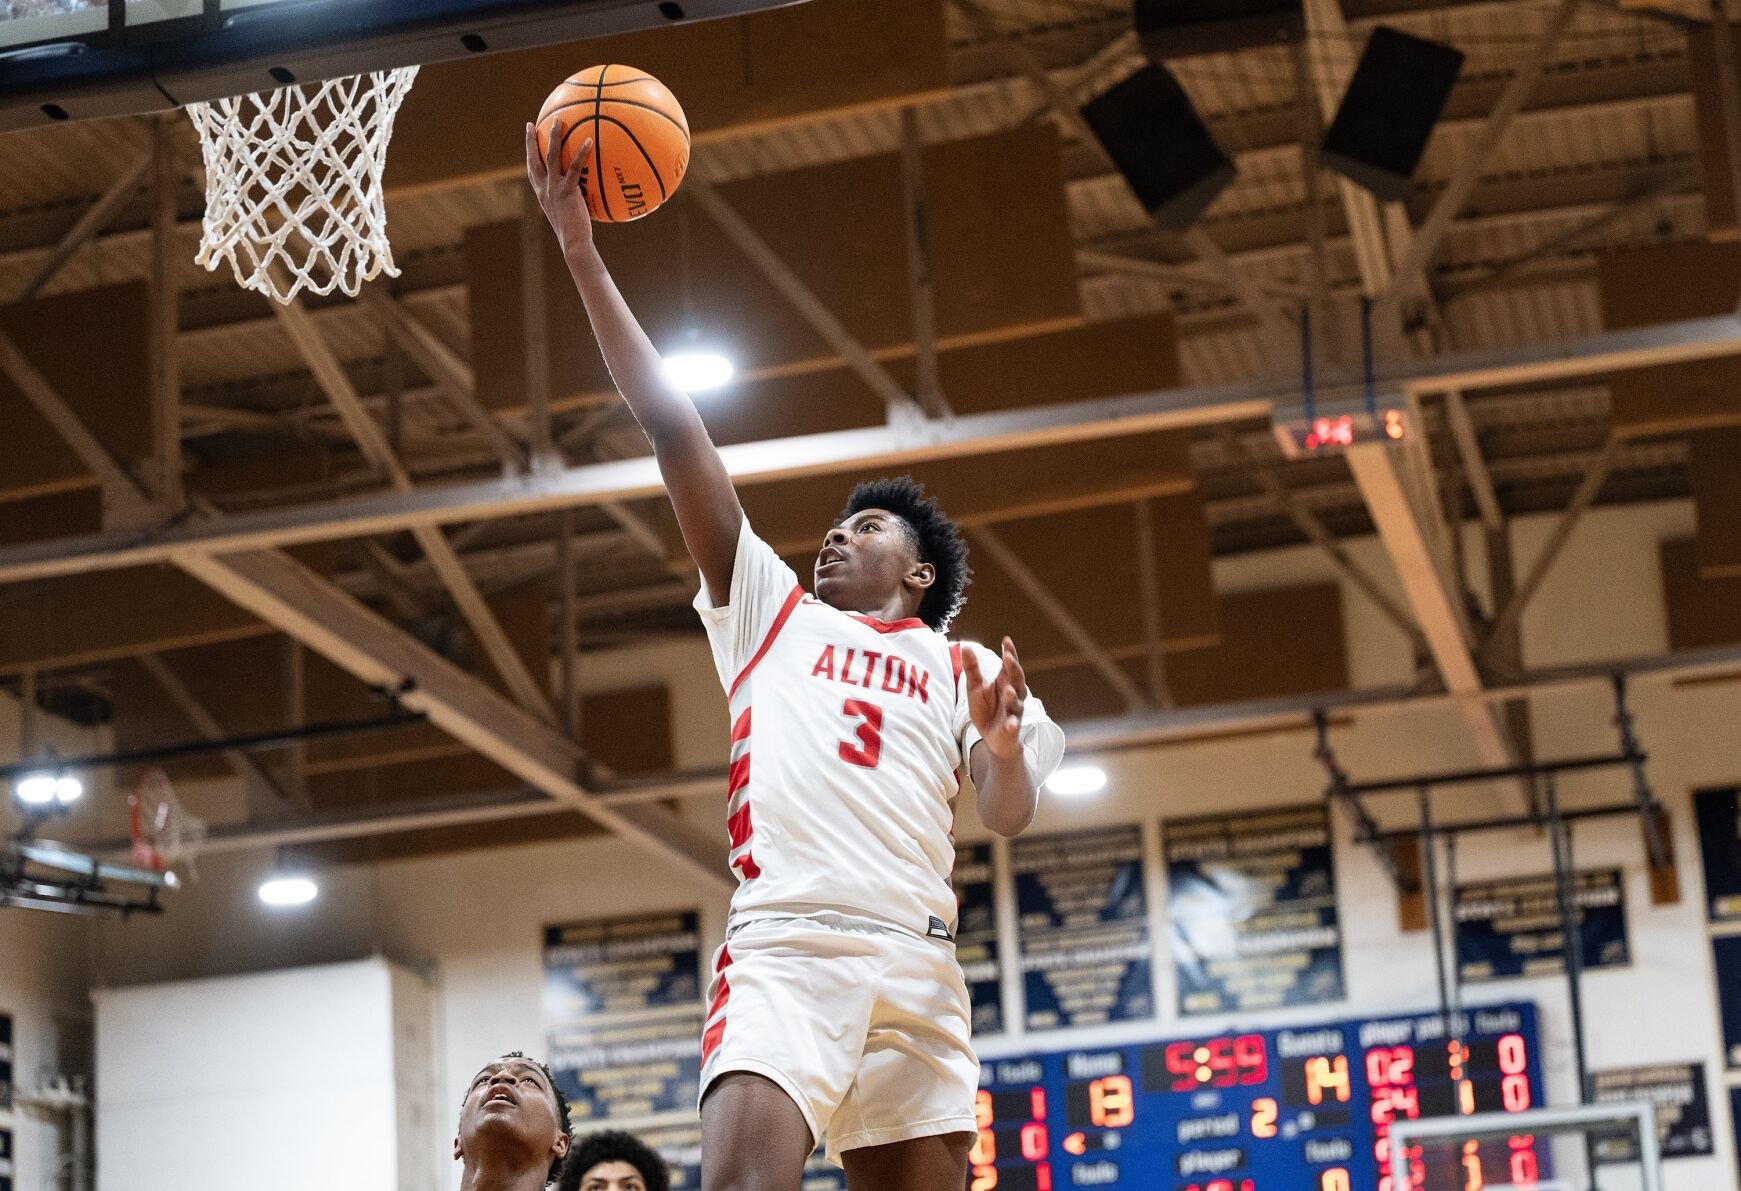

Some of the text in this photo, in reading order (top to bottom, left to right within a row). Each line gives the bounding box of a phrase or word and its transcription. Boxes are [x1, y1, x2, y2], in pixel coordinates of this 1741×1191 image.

[811, 644, 929, 704] ALTON
[837, 697, 884, 769] 3
[1164, 1033, 1269, 1093] 5:59
[1365, 1045, 1415, 1088] 02
[1497, 1034, 1528, 1075] 0
[1088, 1074, 1135, 1127] 13
[1304, 1054, 1352, 1106] 14
[1501, 1074, 1531, 1113] 0
[1030, 1086, 1047, 1122] 1
[1251, 1097, 1278, 1138] 2
[1370, 1084, 1420, 1125] 24
[1020, 1121, 1050, 1162] 0
